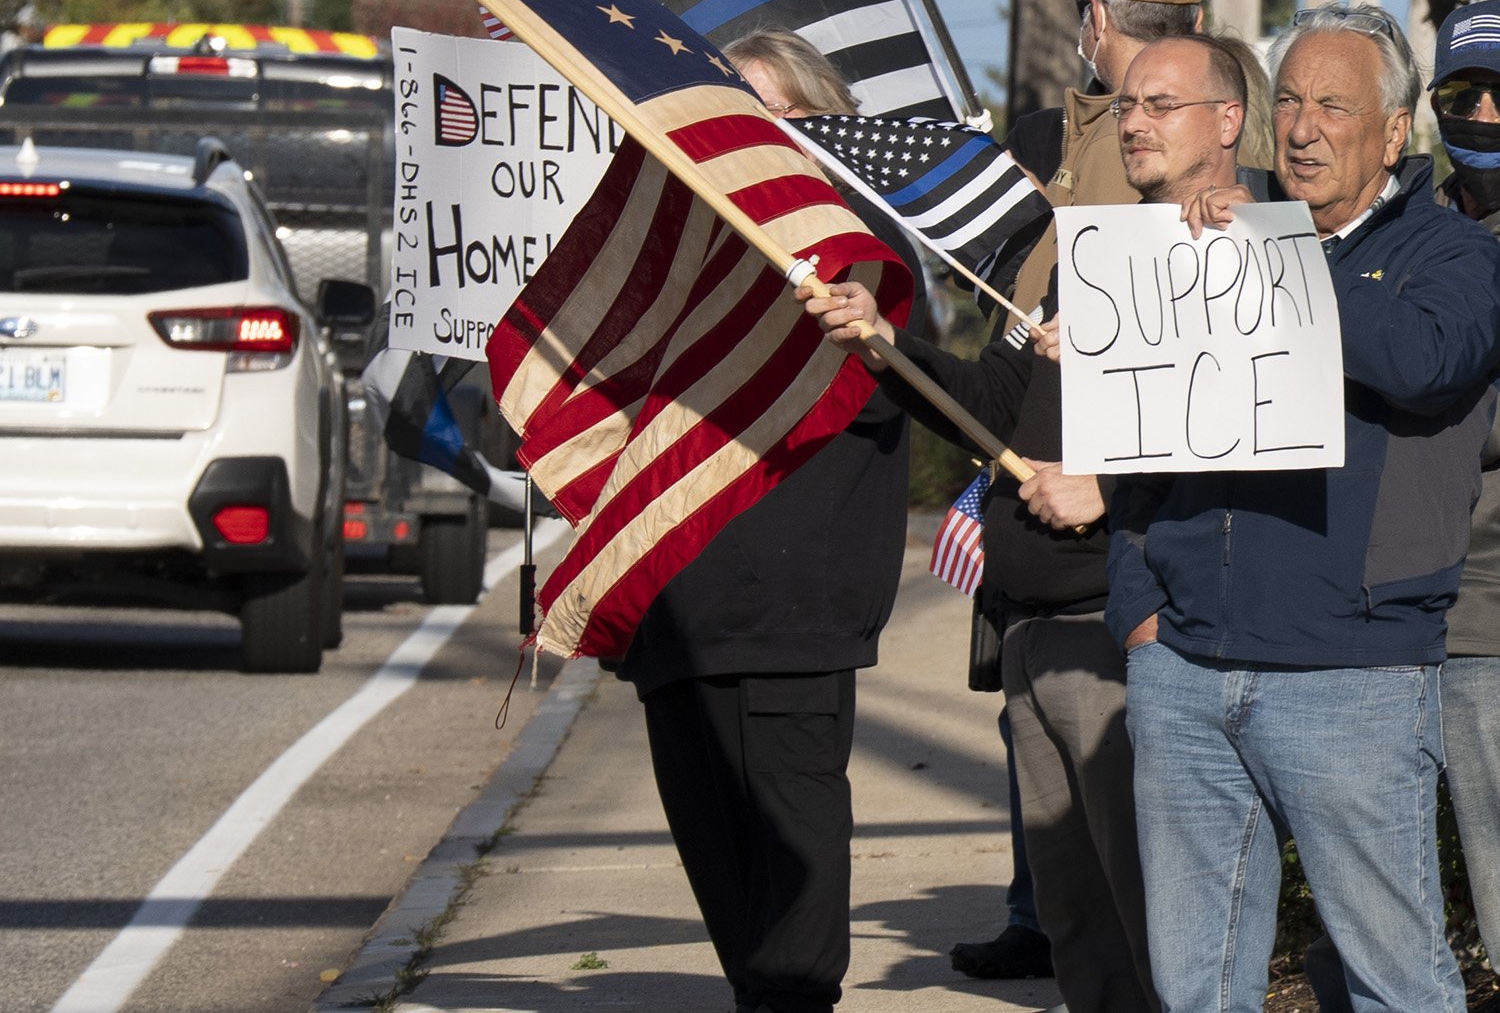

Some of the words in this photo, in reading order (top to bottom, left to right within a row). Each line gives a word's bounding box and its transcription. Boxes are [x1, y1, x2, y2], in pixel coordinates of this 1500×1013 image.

[491, 159, 565, 205] OUR
[425, 200, 552, 289] HOME
[433, 307, 495, 349] SUPPO
[1067, 224, 1319, 357] SUPPORT
[1102, 350, 1325, 463] ICE
